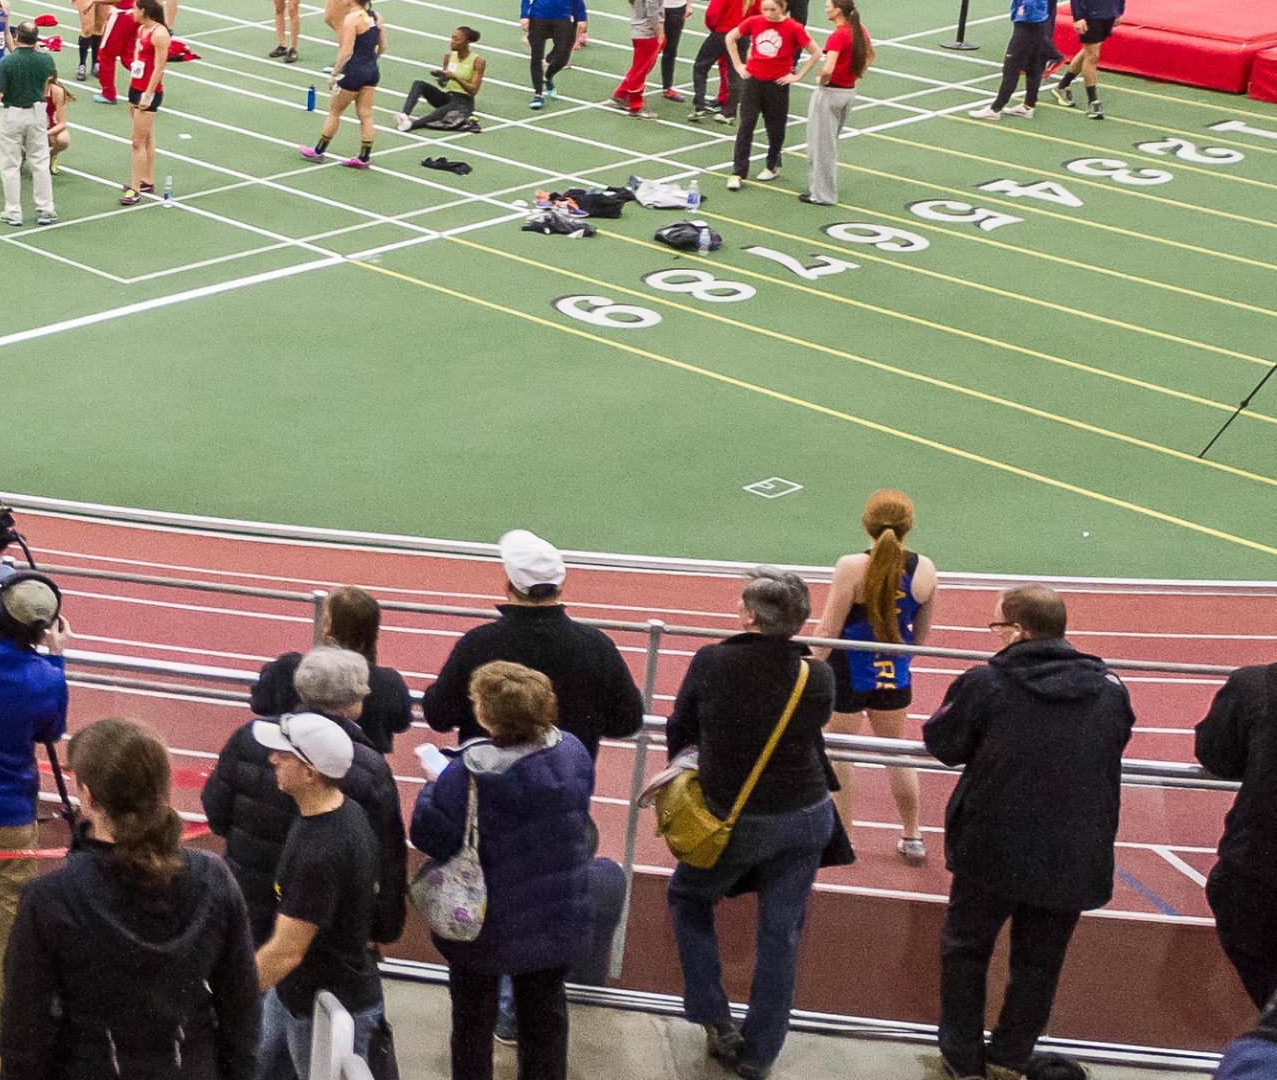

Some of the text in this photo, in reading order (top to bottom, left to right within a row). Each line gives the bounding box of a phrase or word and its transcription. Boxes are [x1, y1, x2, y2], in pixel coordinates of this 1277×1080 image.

[1140, 137, 1245, 164] 2
[1065, 158, 1174, 186] 3
[977, 178, 1085, 208] 4
[909, 200, 1025, 232] 5
[825, 222, 930, 253] 6
[746, 246, 861, 280] 7
[645, 269, 758, 303] 8
[555, 295, 663, 329] 9
